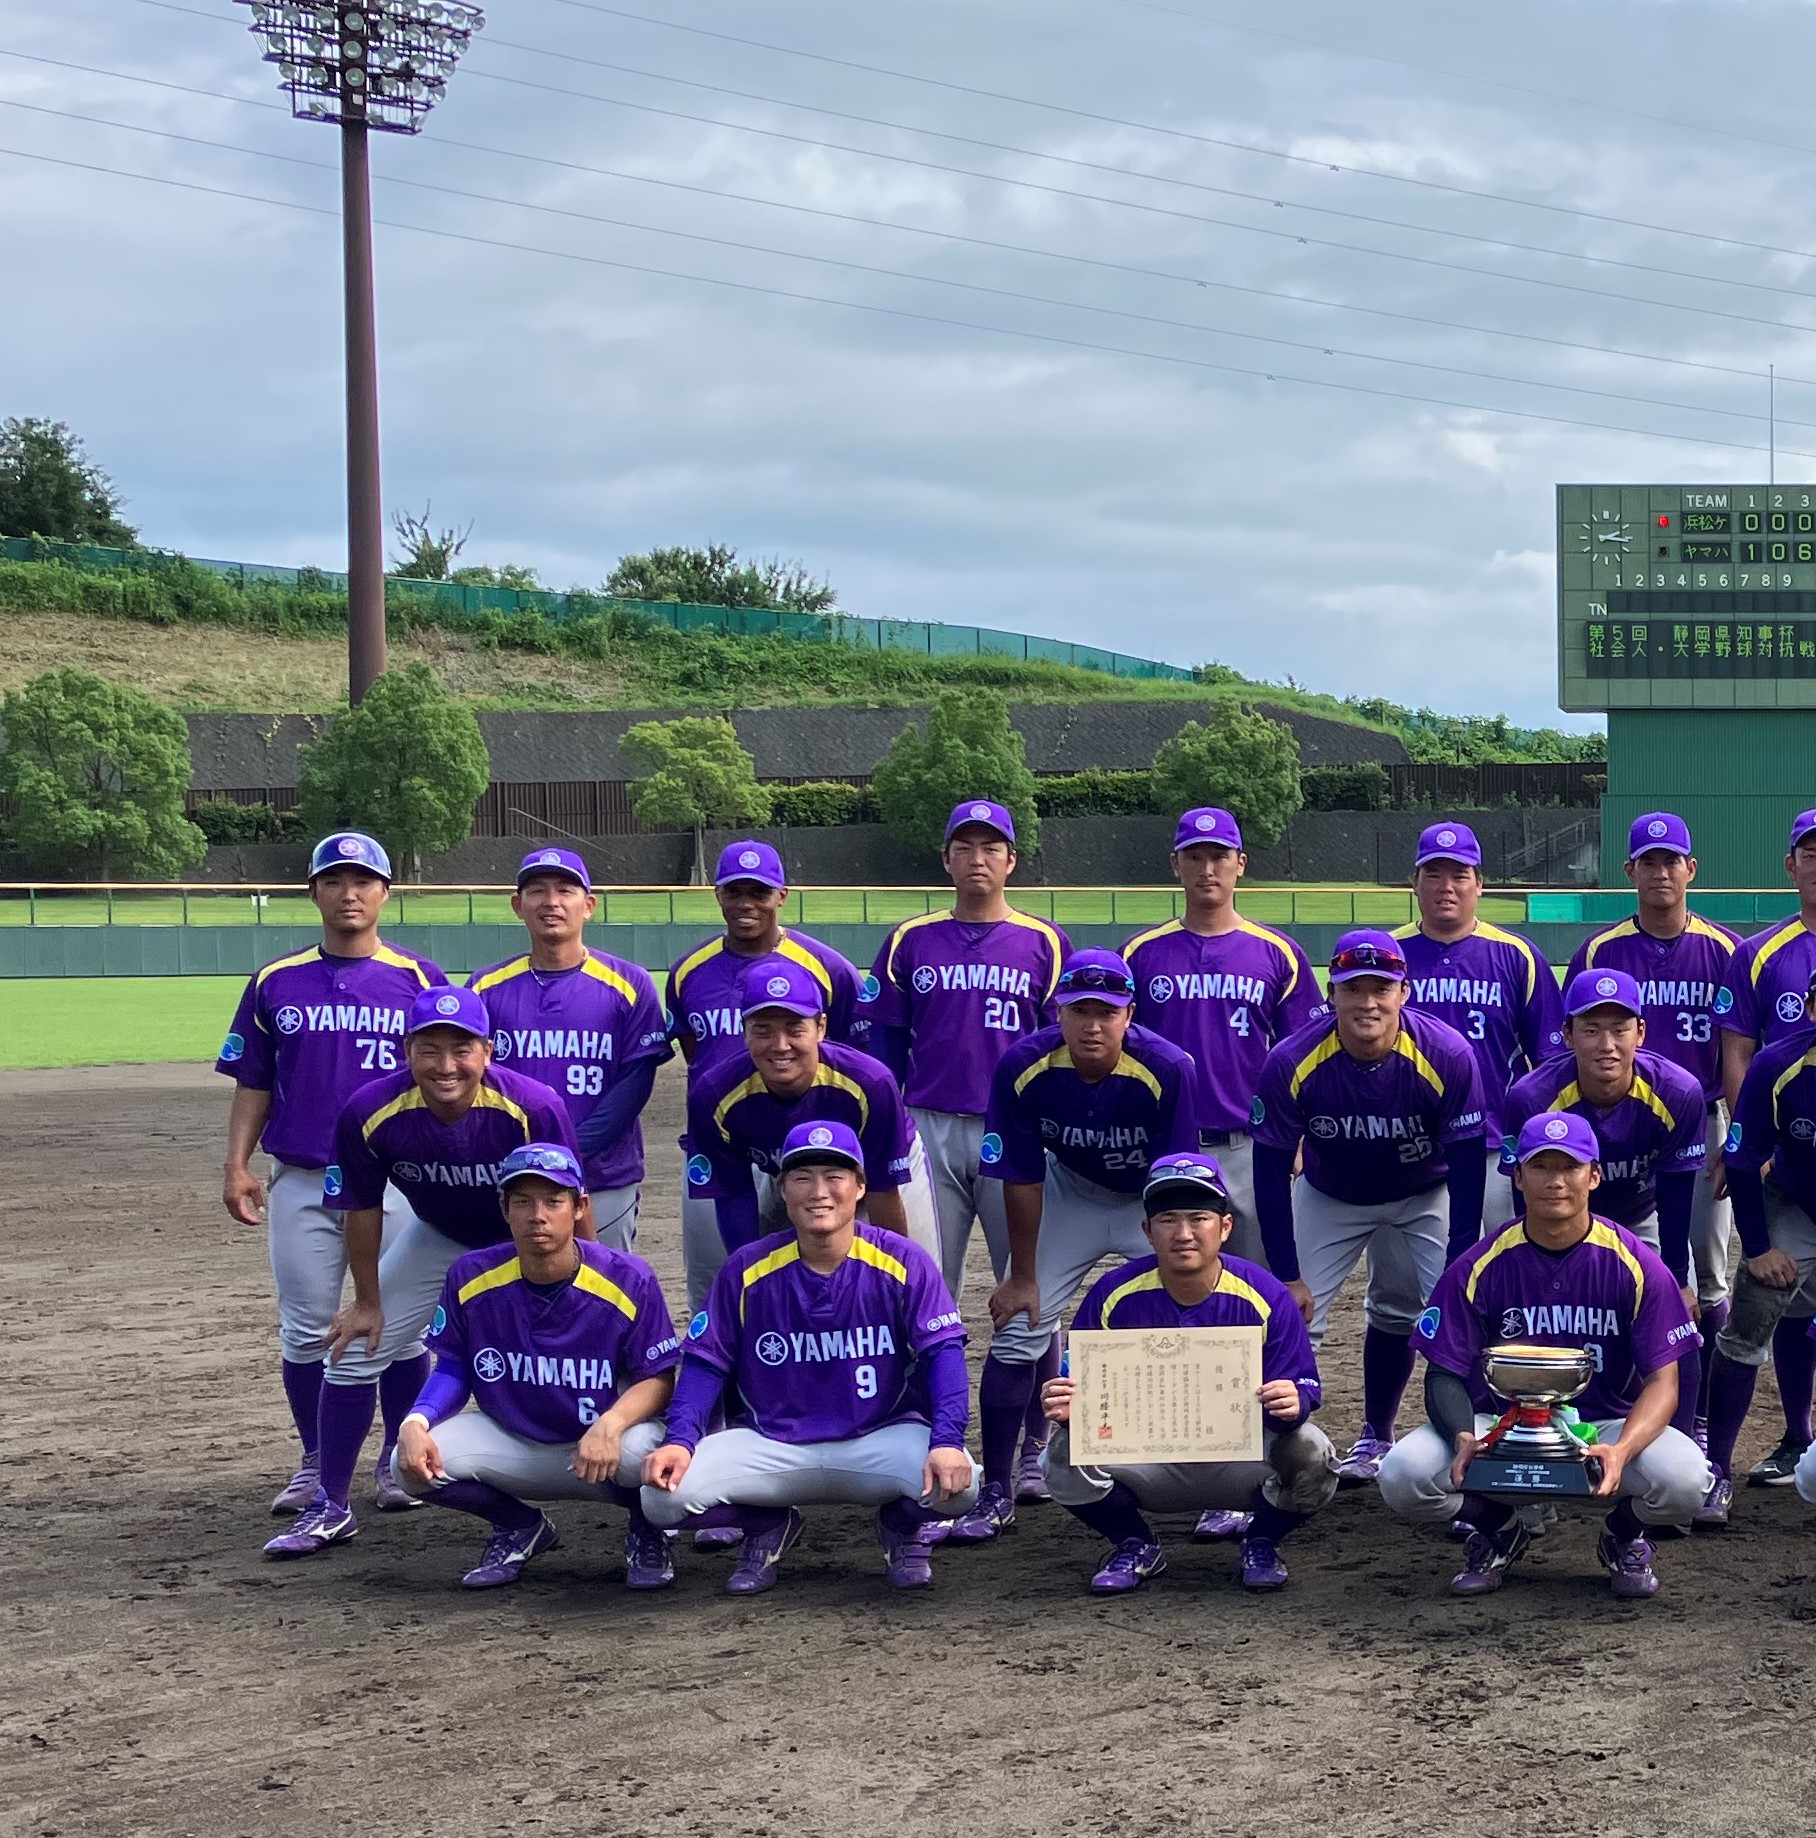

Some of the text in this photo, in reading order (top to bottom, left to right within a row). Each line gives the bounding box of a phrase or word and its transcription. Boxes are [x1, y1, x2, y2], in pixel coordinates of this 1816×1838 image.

[1686, 494, 1728, 508] TEAM
[1748, 494, 1756, 507] 1
[1773, 494, 1785, 507] 2
[1800, 494, 1811, 507] 3
[1745, 514, 1759, 531] 0
[1772, 514, 1785, 531] 0
[1798, 514, 1812, 531] 0
[1684, 543, 1729, 560] ヤマハ
[1748, 543, 1755, 560] 1
[1772, 543, 1785, 560] 0
[1798, 543, 1812, 560] 6
[1614, 574, 1793, 587] 1 2 3 4 5 6 7 8 9
[1589, 603, 1608, 616] TN
[939, 964, 1030, 998] YAMAHA
[1175, 974, 1265, 1006] YAMAHA
[1413, 977, 1501, 1007] YAMAHA
[305, 1004, 405, 1036] YAMAHA
[984, 999, 1019, 1031] 20
[1229, 1005, 1249, 1037] 4
[1467, 1009, 1485, 1040] 3
[1676, 1012, 1711, 1042] 33
[356, 1038, 396, 1070] 76
[513, 1030, 612, 1061] YAMAHA
[566, 1064, 603, 1095] 93
[424, 1160, 503, 1188] YAMAH
[1103, 1149, 1149, 1170] 24
[1522, 1304, 1619, 1336] YAMAHA
[789, 1325, 895, 1362] YAMAHA
[507, 1352, 613, 1389] YAMAHA
[854, 1364, 878, 1399] 9
[578, 1396, 598, 1426] 6
